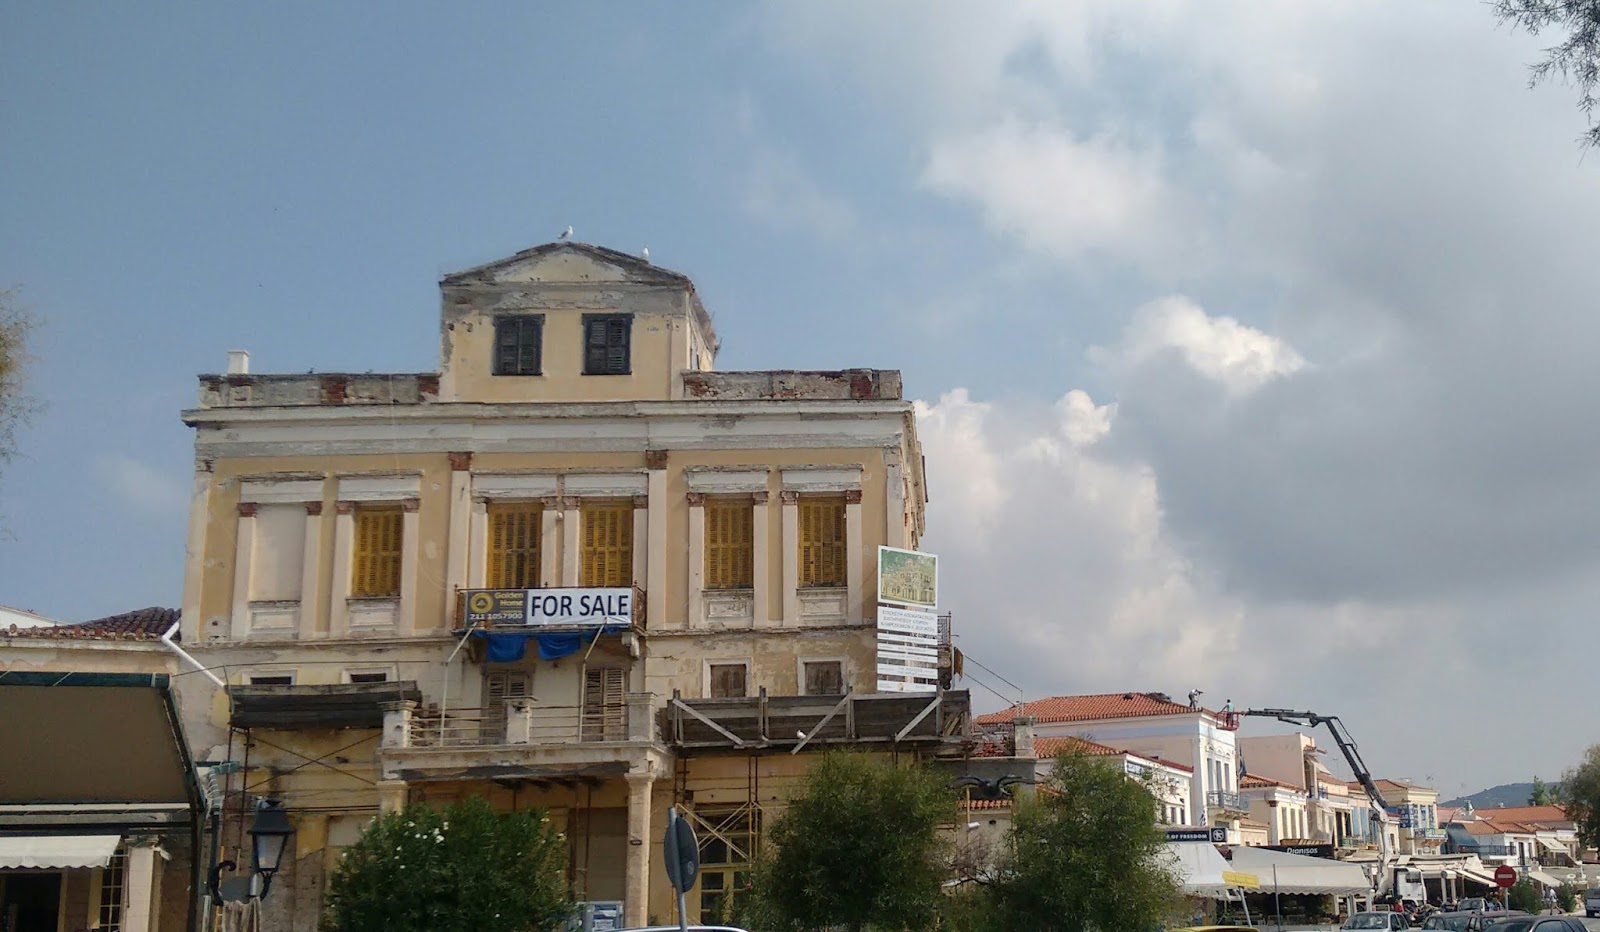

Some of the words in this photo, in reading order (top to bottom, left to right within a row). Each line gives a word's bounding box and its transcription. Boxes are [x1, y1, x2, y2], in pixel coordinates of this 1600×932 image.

[531, 595, 572, 617] FOR
[579, 595, 629, 616] SALE
[1286, 847, 1318, 855] Dionisos
